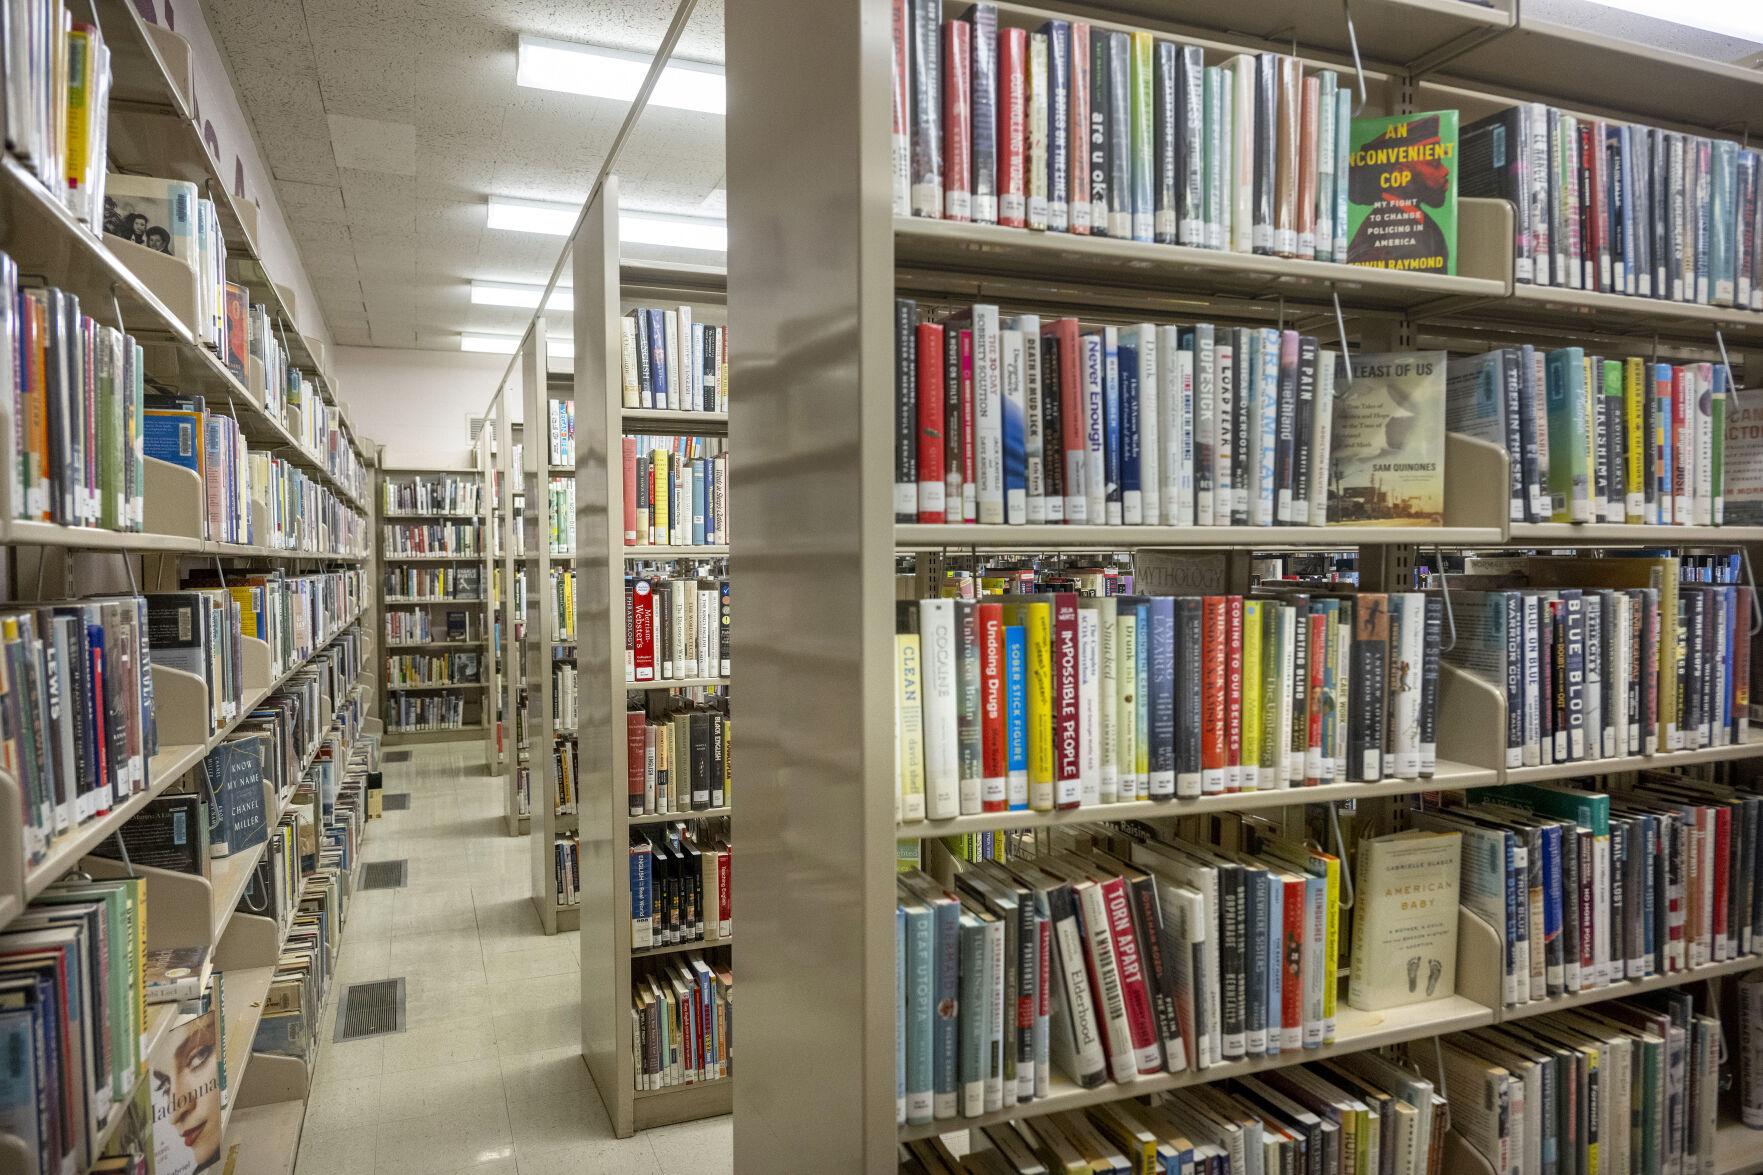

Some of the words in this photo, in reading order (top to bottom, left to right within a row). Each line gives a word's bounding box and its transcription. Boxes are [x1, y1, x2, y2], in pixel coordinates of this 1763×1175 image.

[1092, 112, 1106, 143] are
[1385, 124, 1407, 139] AN
[1092, 152, 1106, 163] u
[1349, 143, 1454, 167] NCONVENIENT
[1010, 156, 1023, 194] WOME
[1380, 171, 1412, 188] COP
[1368, 226, 1410, 234] POLICING
[1414, 224, 1424, 232] IN
[1374, 238, 1416, 248] AMERICA
[1388, 256, 1444, 270] RAYMOND
[977, 314, 987, 362] SOBRIETY
[988, 334, 997, 355] THE
[1028, 339, 1036, 370] DEATH
[1301, 345, 1314, 360] IN
[950, 367, 957, 378] ON
[1028, 374, 1036, 384] IN
[1089, 341, 1100, 387] Never
[1200, 339, 1214, 420] DOPESICK
[1354, 366, 1392, 378] LEAST
[1395, 364, 1411, 376] OF
[1416, 364, 1433, 376] US
[977, 366, 987, 418] SOLUTION
[1300, 367, 1314, 400] PAIN
[1508, 368, 1519, 412] TIGER
[1030, 414, 1038, 436] LICK
[1088, 392, 1102, 452] Enough
[1238, 402, 1248, 462] OVERDOSE
[1509, 414, 1520, 430] IN
[1510, 432, 1520, 462] THE
[1596, 394, 1606, 487] FUKUSHIMA
[1373, 464, 1391, 472] SAM
[1394, 463, 1436, 472] QUINONES
[1512, 462, 1522, 491] SEA
[1137, 567, 1224, 588] MYTHOLOGY
[635, 604, 644, 648] Webster's
[644, 608, 652, 642] Merriam-
[1216, 602, 1226, 640] WHEN
[1231, 602, 1240, 648] COMING
[1508, 599, 1516, 662] WARRIOR
[1528, 603, 1538, 632] BLUE
[1568, 600, 1581, 655] BLUE
[964, 617, 975, 680] Unbroken
[986, 620, 999, 676] Undoing
[1103, 621, 1115, 680] Smacked
[1126, 625, 1134, 661] Drunk
[1154, 614, 1165, 682] LAZARUS
[1296, 618, 1306, 664] FIGHTING
[1528, 637, 1538, 652] ON
[141, 637, 150, 707] LINCOLN
[904, 646, 916, 702] CLEAN
[935, 625, 950, 698] COCAINE
[1012, 644, 1021, 680] SOBER
[1061, 630, 1074, 716] IMPOSSIBLE
[1216, 644, 1226, 688] CRACK
[1231, 654, 1240, 669] TO
[1426, 648, 1441, 680] SEEN
[1528, 657, 1538, 686] BLUE
[46, 646, 60, 720] LEWIS
[1231, 674, 1240, 698] OUR
[1296, 668, 1306, 699] BLIND
[1508, 666, 1516, 694] COP
[964, 686, 975, 720] Brain
[987, 678, 1000, 719] Drugs
[1012, 684, 1021, 716] STICK
[1216, 691, 1226, 719] WAS
[1570, 670, 1582, 725] BLOO
[714, 716, 722, 734] BLACK
[1216, 722, 1226, 753] KING
[1231, 704, 1240, 750] SENSES
[714, 736, 722, 760] ENGLISH
[1063, 720, 1076, 778] PEOPLE
[227, 782, 237, 790] MY
[240, 774, 259, 786] NAME
[231, 760, 252, 773] KNOW
[232, 800, 259, 816] CHANEL
[234, 816, 259, 831] MILLER
[1614, 830, 1622, 860] TRAIL
[1255, 877, 1265, 934] SOMEWHERE
[1385, 882, 1452, 897] AMERICAN
[1401, 900, 1435, 911] BABY
[1110, 888, 1130, 932] TORN
[916, 920, 928, 959] DEAF
[1255, 937, 1265, 972] SISTERS
[1118, 936, 1142, 984] APART
[916, 965, 928, 1022] UTOPIA
[1070, 968, 1095, 1046] Elderhood
